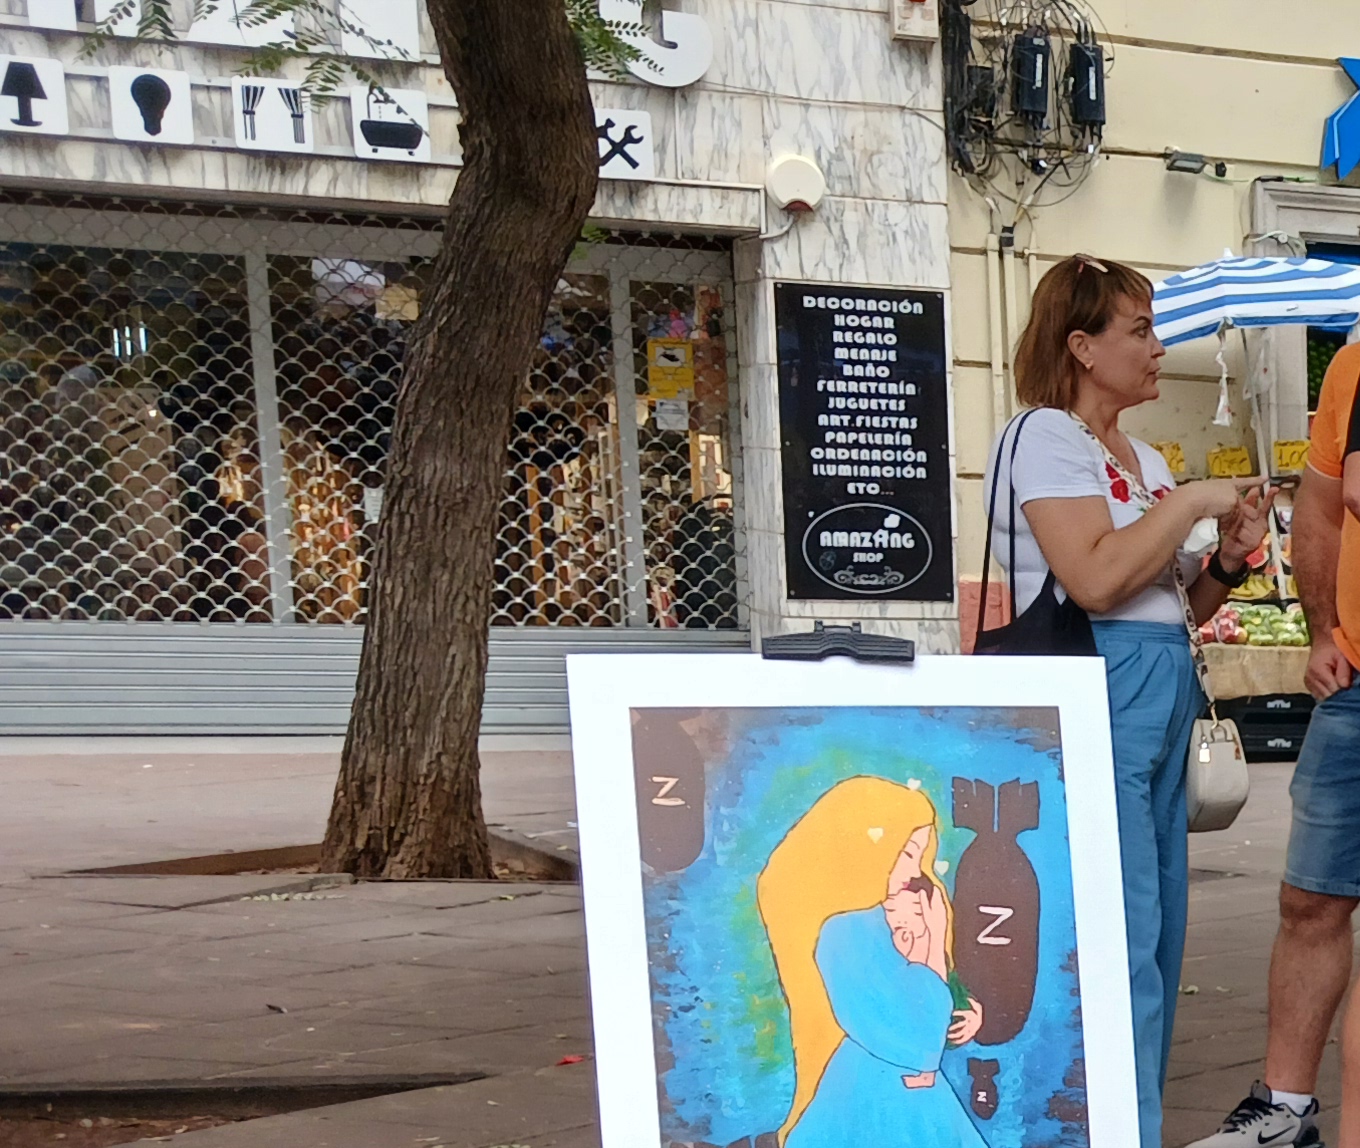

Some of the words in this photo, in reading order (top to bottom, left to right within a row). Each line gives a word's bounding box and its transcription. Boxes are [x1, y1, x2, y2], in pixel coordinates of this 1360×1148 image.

[802, 295, 924, 314] DECORACIÓN
[834, 314, 895, 329] HOGAR
[832, 330, 897, 345] REGALO
[834, 347, 897, 362] MENAJE
[842, 362, 890, 378] BAÑO
[816, 379, 916, 395] FERRETERÍA
[828, 396, 906, 411] JUGUETES
[817, 414, 918, 429] ART.FIESTAS
[825, 431, 912, 446] PAPELERÍA
[810, 447, 927, 463] ORDENACIÓN
[812, 463, 927, 479] ILUMINACIÓN
[853, 552, 884, 563] SHOP
[652, 776, 686, 806] Z
[976, 905, 1014, 945] Z
